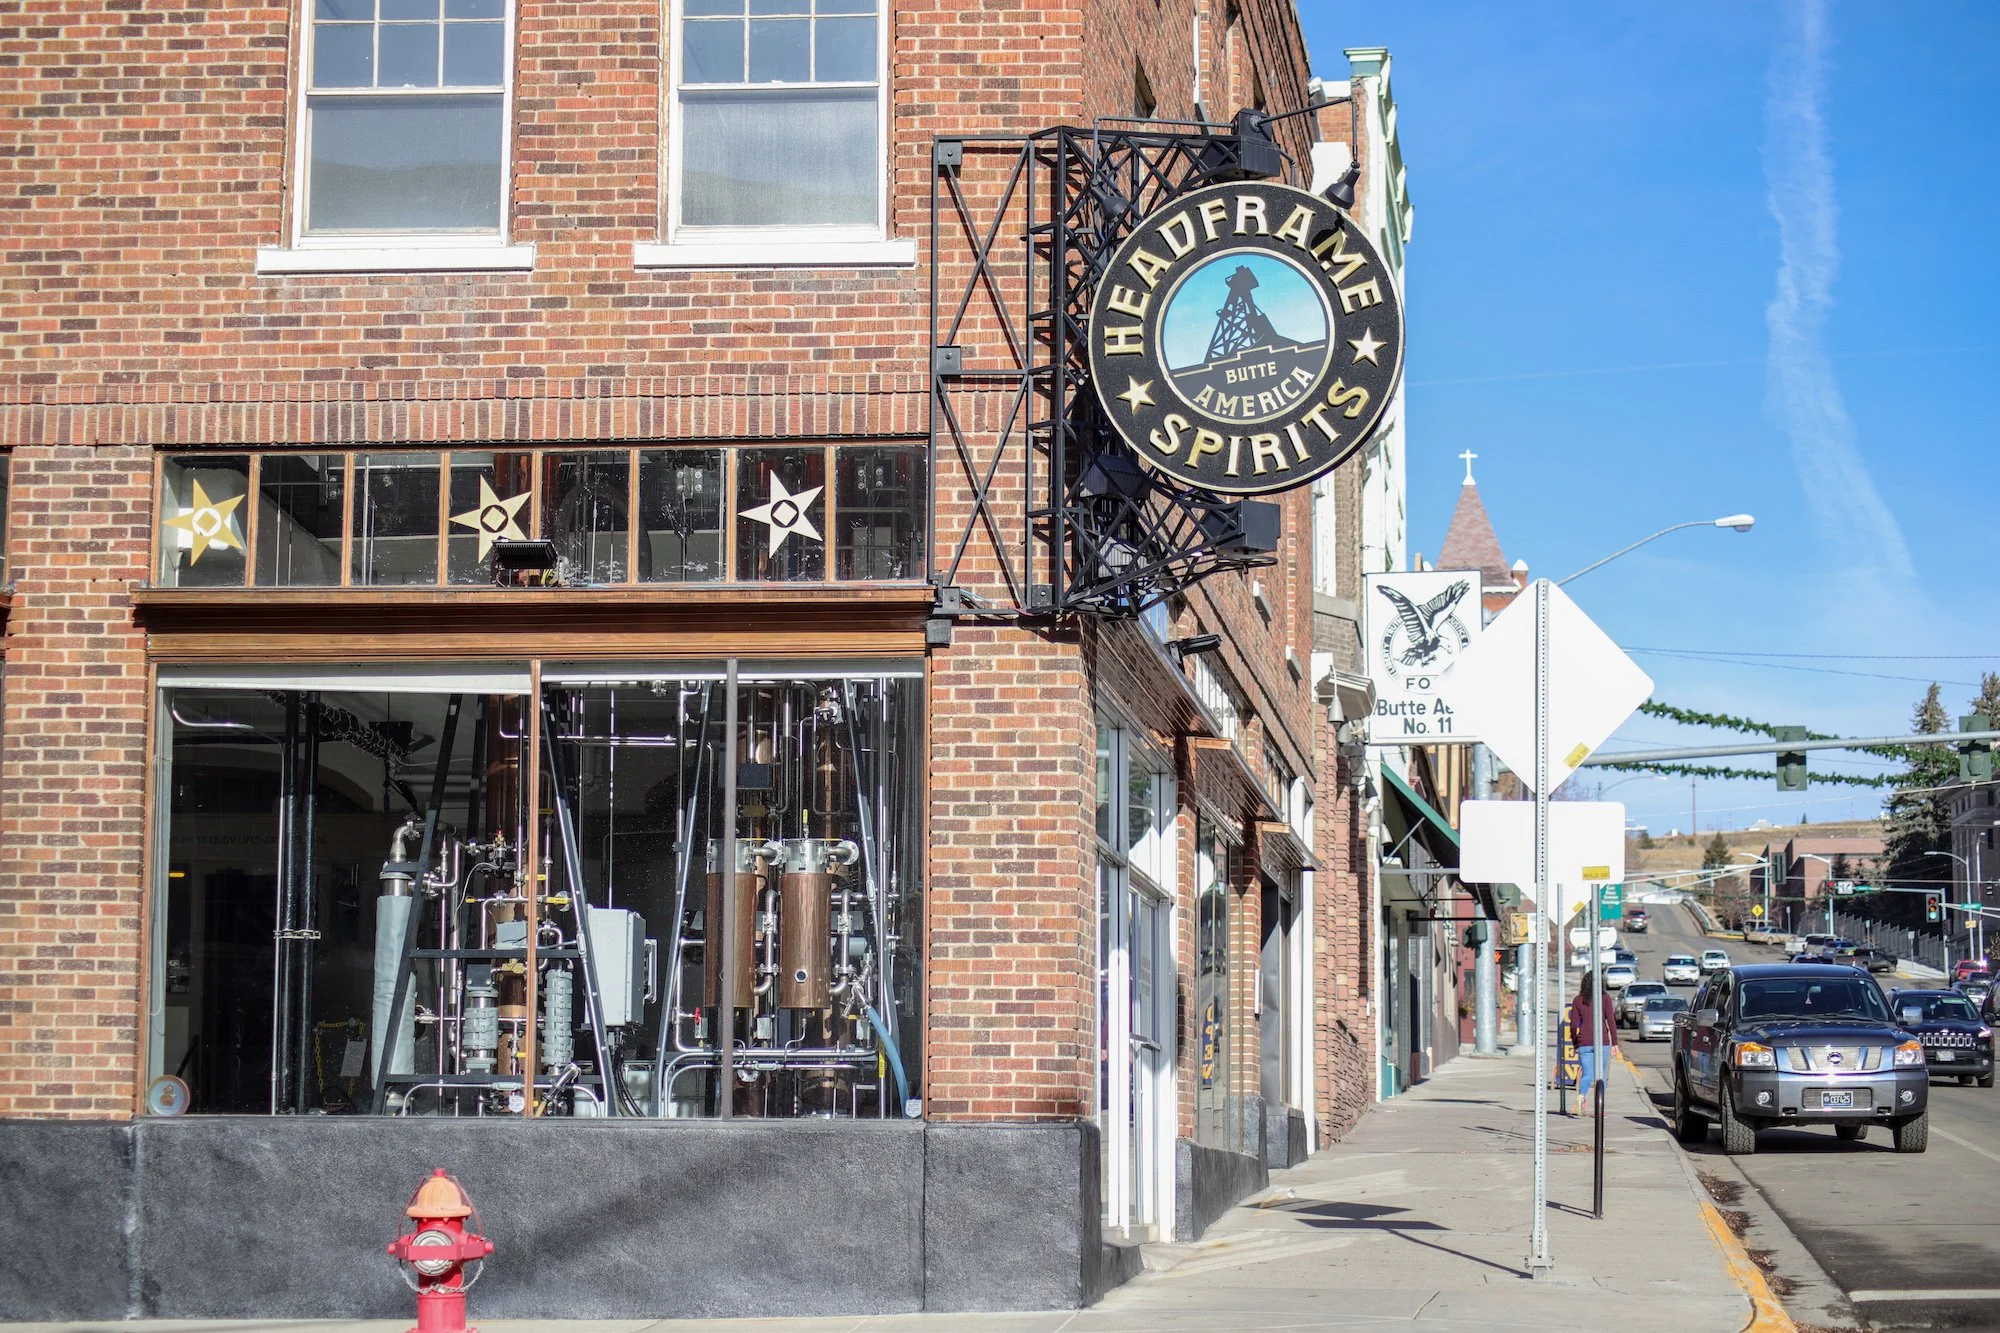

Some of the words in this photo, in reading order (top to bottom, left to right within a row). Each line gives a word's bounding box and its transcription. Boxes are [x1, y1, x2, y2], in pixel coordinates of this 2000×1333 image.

[1104, 196, 1384, 357] HEADFRAME
[1193, 366, 1316, 418] AMERICA
[1225, 361, 1277, 385] BUTTE
[1150, 377, 1370, 477] SPIRITS
[1377, 699, 1426, 716] Butte
[1403, 717, 1430, 734] No.
